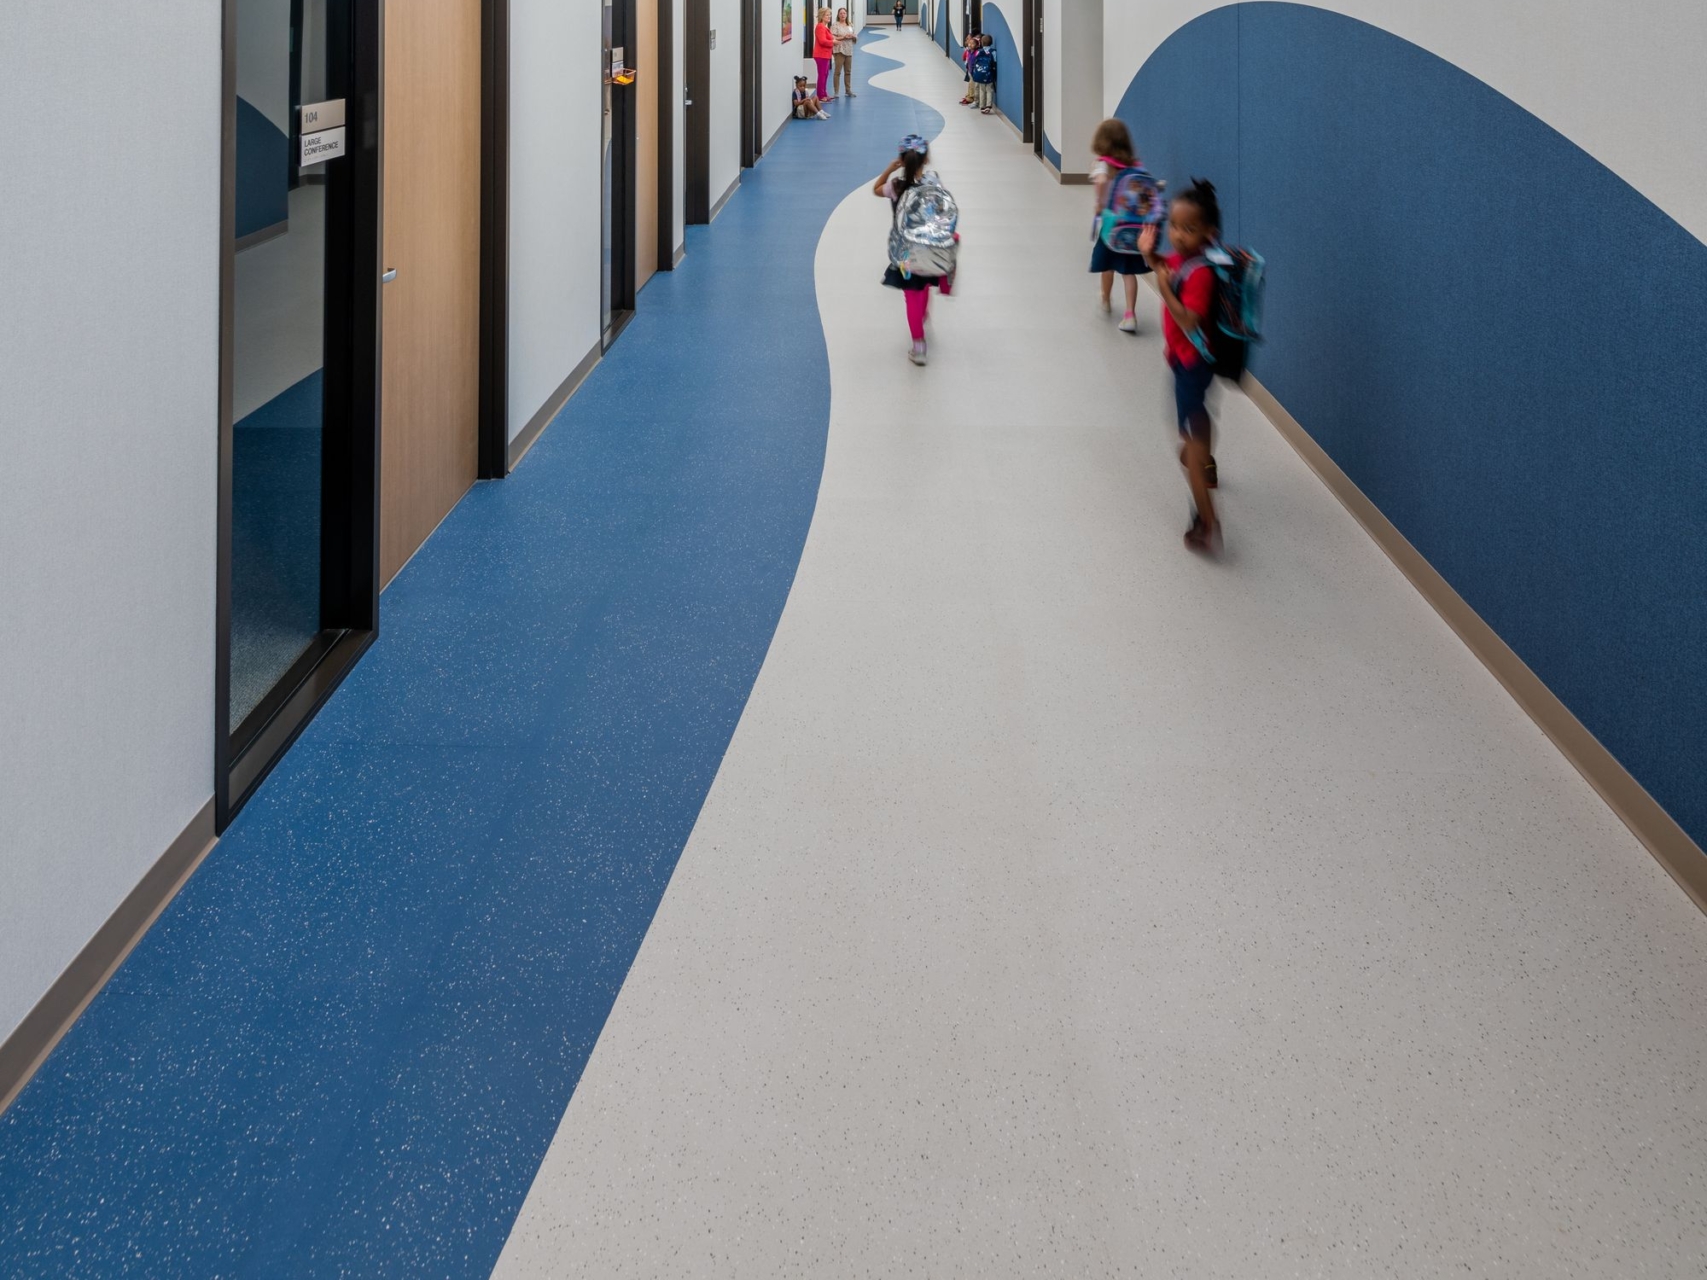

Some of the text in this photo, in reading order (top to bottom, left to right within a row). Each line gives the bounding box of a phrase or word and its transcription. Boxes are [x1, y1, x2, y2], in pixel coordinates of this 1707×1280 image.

[304, 111, 318, 123] 104
[304, 137, 321, 147] LARGE
[304, 141, 339, 156] CONFERENCE
